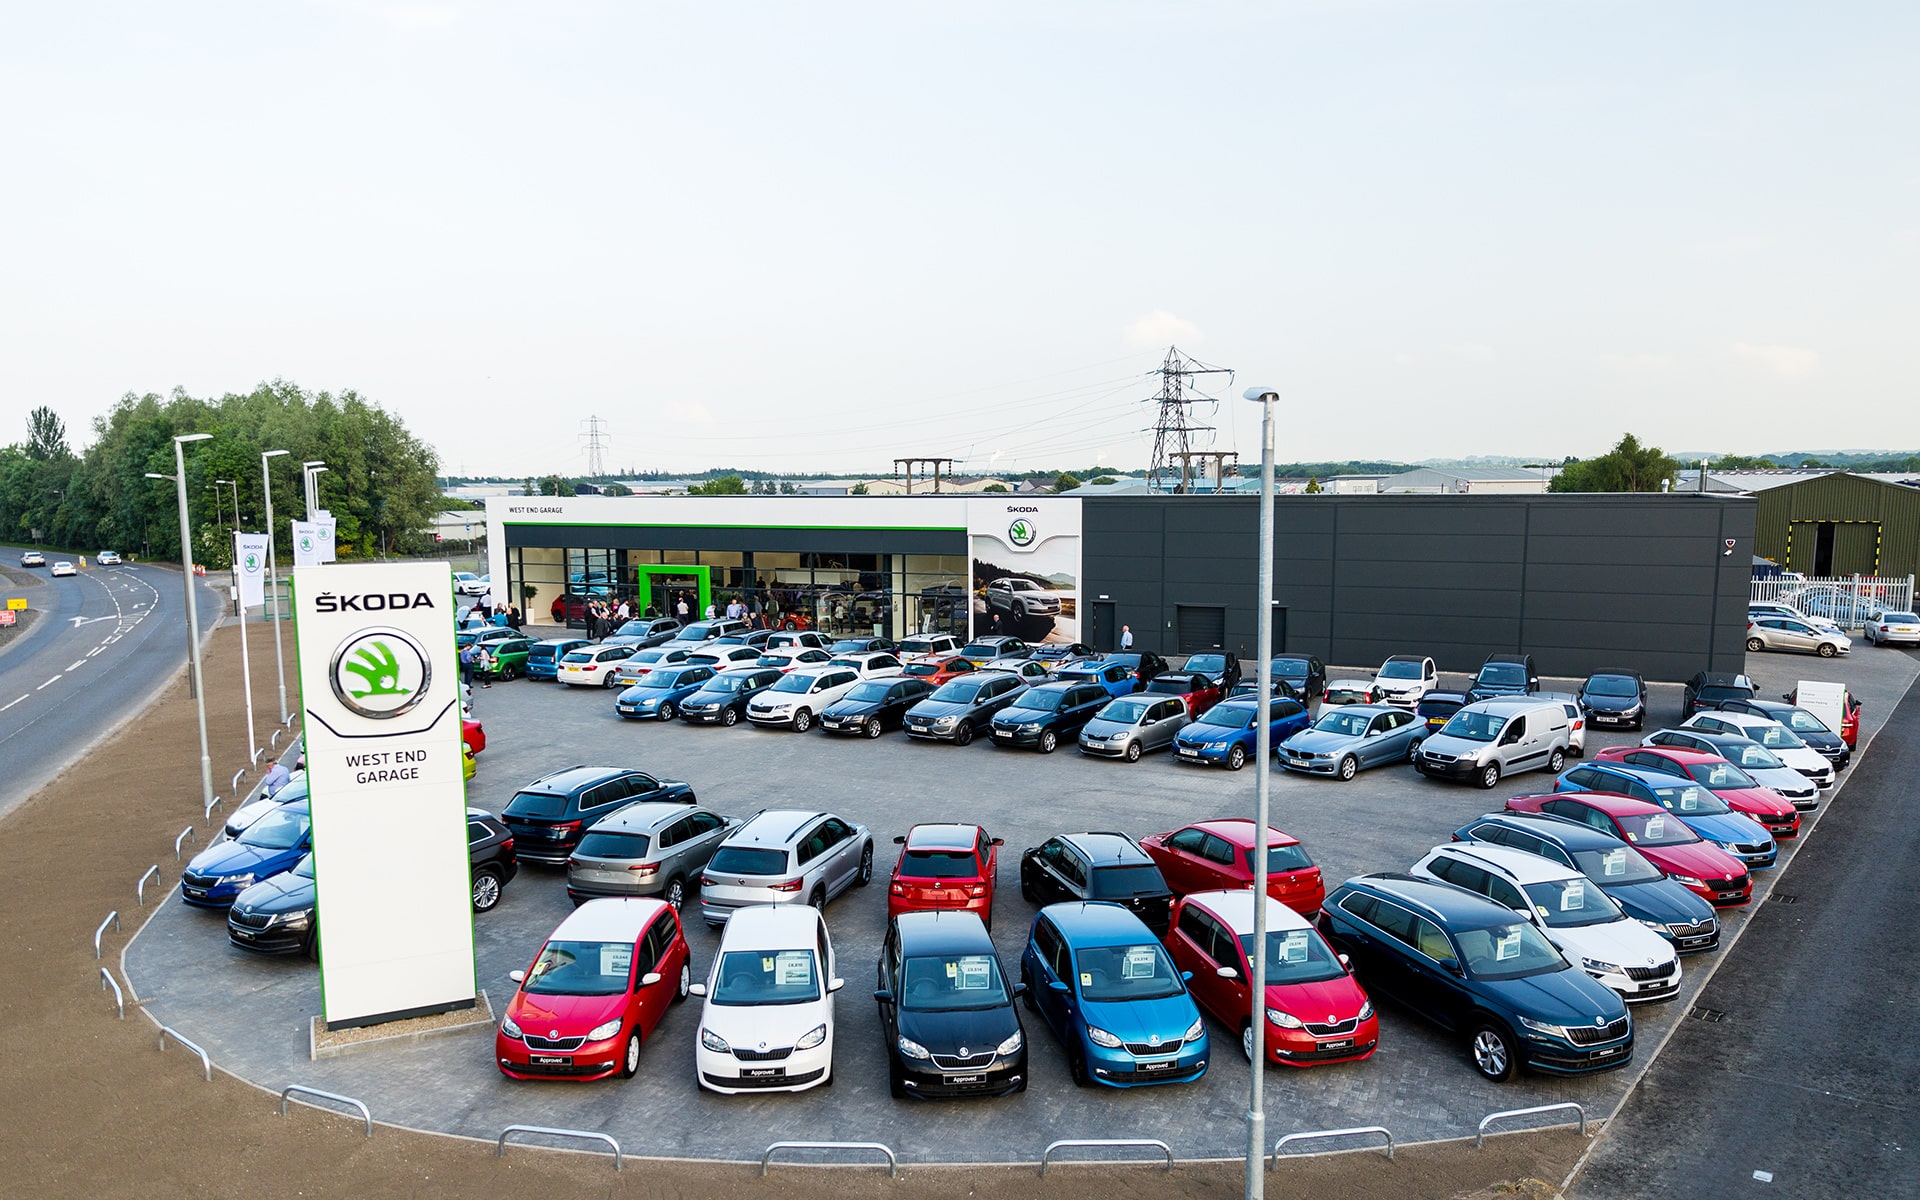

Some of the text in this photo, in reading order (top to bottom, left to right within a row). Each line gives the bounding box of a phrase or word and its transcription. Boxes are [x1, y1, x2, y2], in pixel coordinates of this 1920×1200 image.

[315, 591, 435, 613] ŠKODA
[346, 749, 427, 767] WEST END
[356, 767, 419, 784] GARAGE
[1326, 1041, 1346, 1049] Approved
[953, 1075, 976, 1083] Approved
